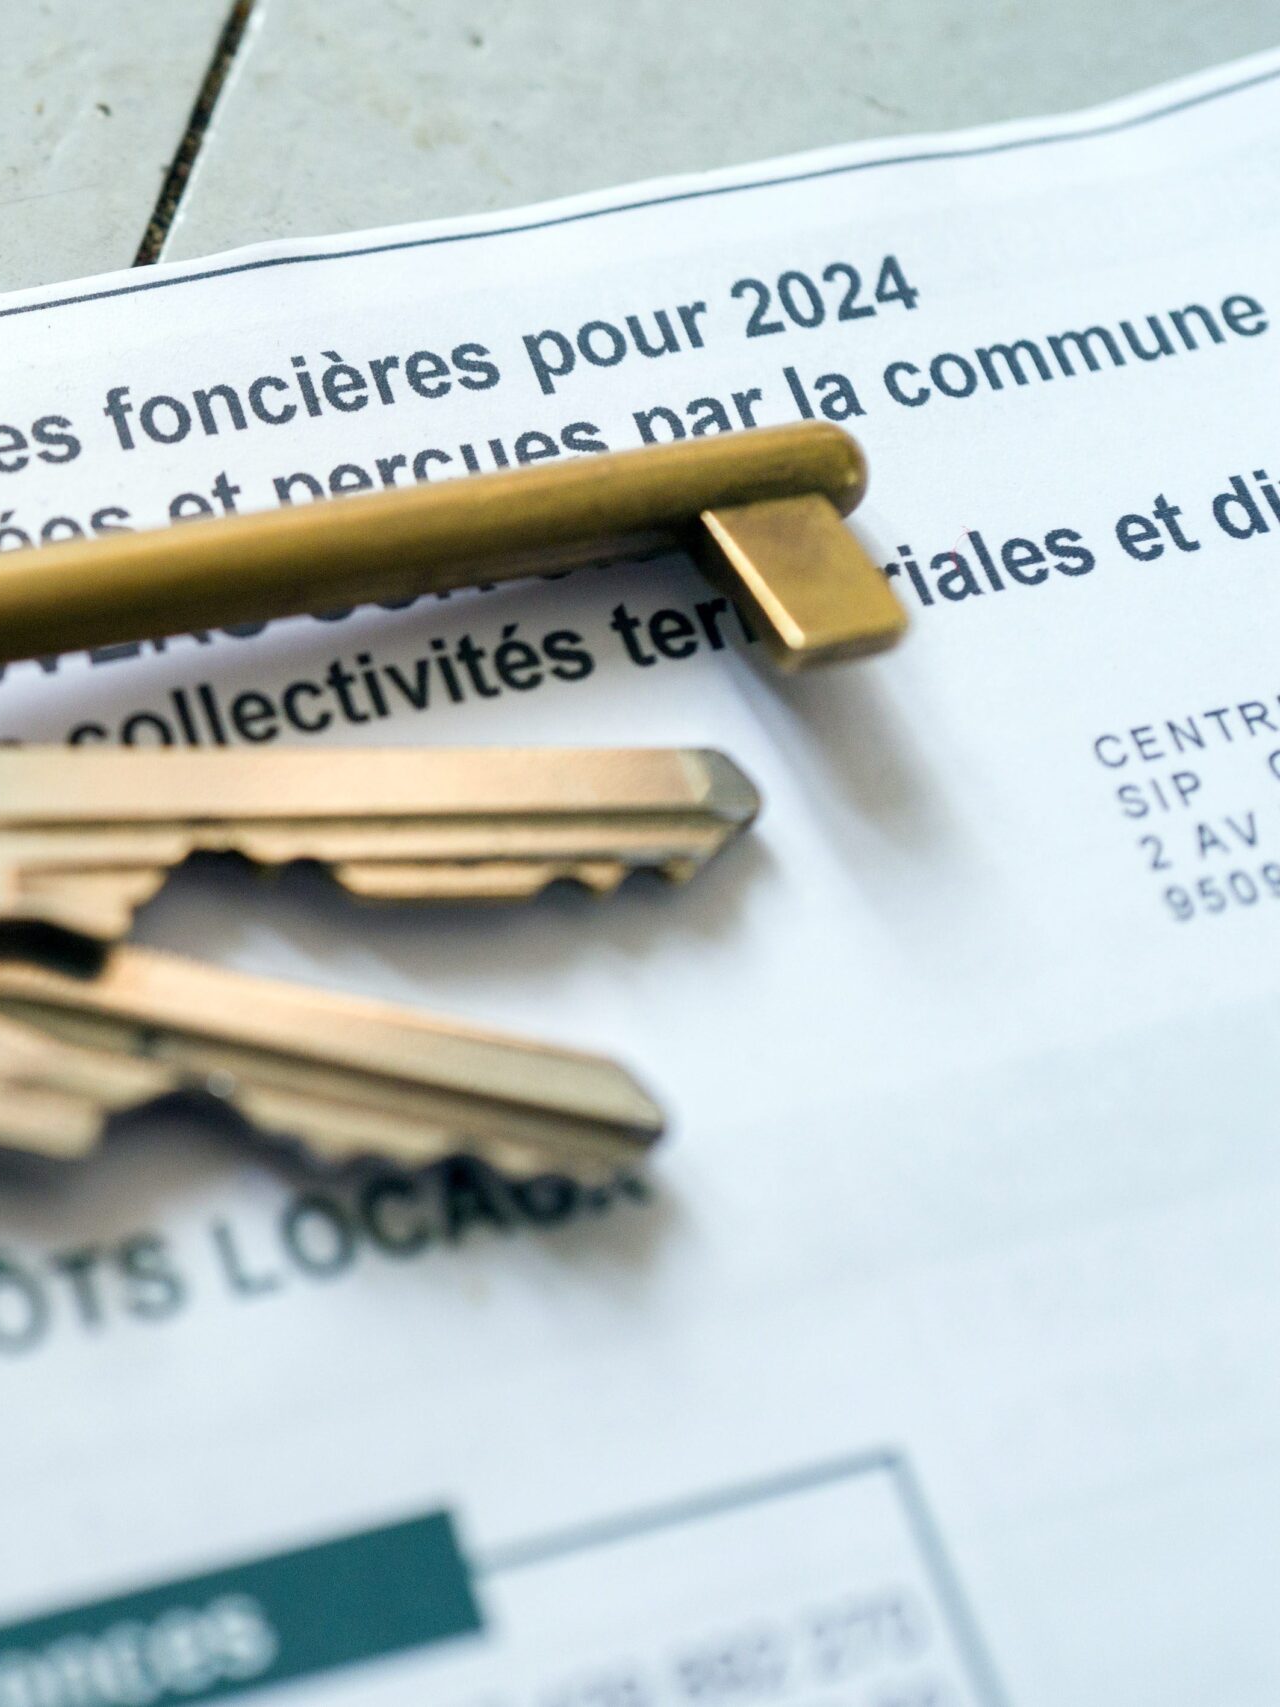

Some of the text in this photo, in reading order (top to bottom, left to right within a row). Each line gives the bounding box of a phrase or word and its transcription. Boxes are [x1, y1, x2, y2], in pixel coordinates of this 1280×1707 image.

[104, 343, 501, 450] foncières
[521, 301, 707, 394] pour
[729, 256, 919, 337] 2024
[168, 471, 242, 525] et
[633, 387, 763, 446] par
[783, 366, 867, 421] la
[883, 293, 1269, 408] commune
[1116, 493, 1201, 561] et
[1212, 469, 1280, 540] di
[1093, 694, 1280, 769] CENTR
[1117, 771, 1202, 819] SIP
[1138, 811, 1258, 871] 2 AV
